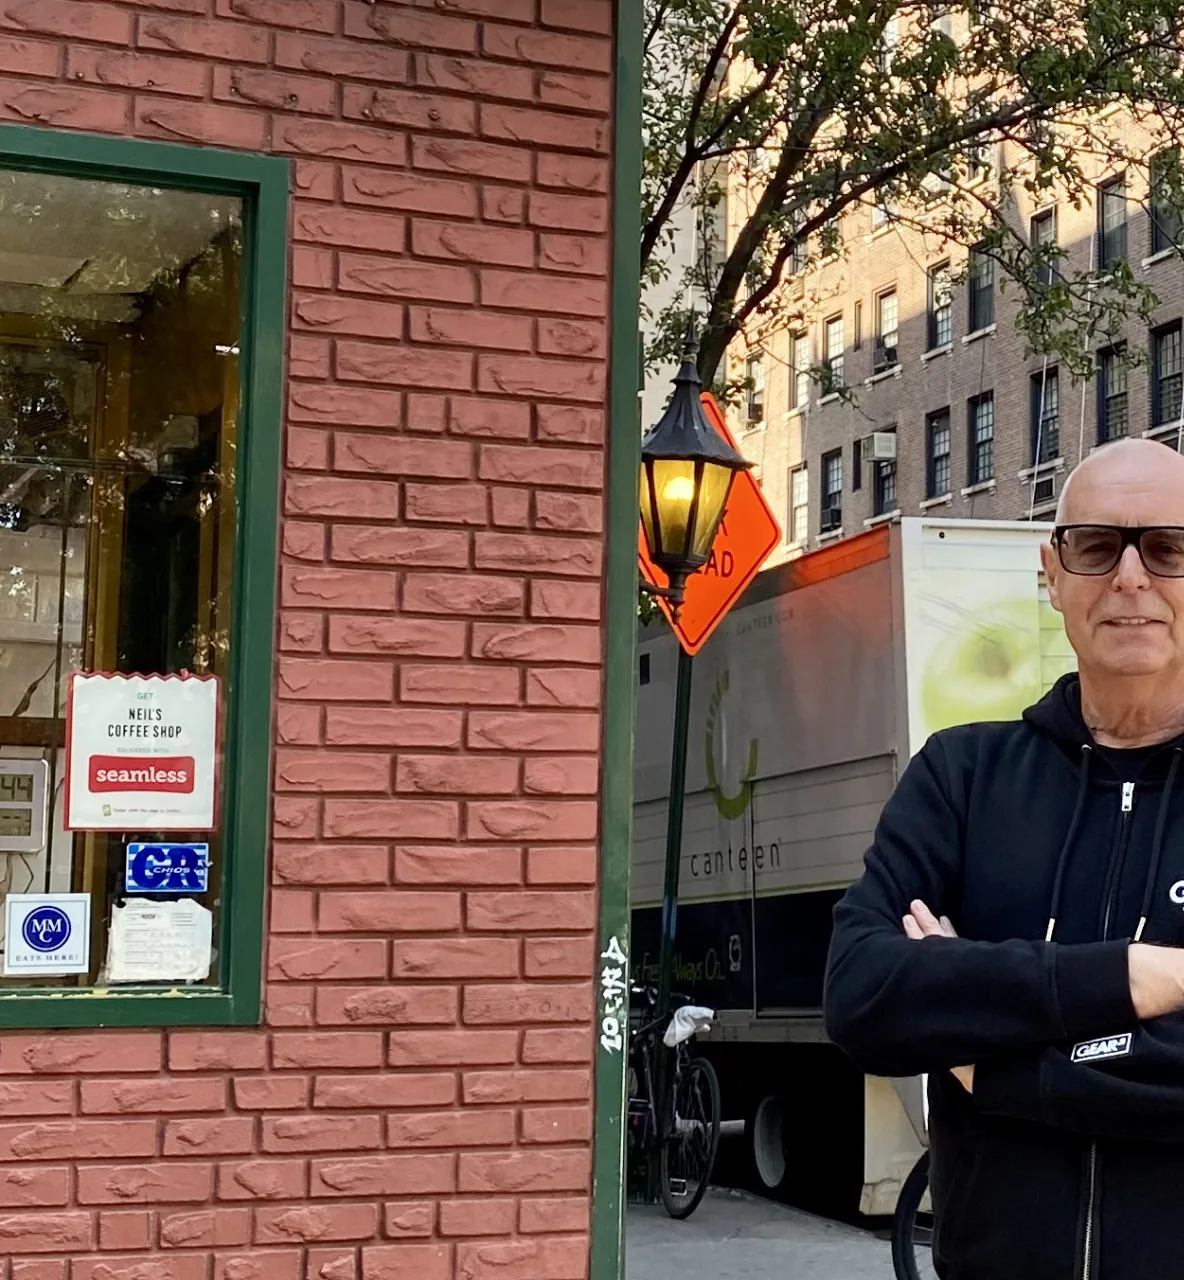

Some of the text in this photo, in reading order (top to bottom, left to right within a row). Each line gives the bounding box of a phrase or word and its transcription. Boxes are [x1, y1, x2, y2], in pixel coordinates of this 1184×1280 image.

[136, 692, 154, 700] GET
[129, 708, 162, 721] NEIL'S
[108, 724, 182, 738] COFFEE SHOP
[96, 766, 188, 783] seamless
[691, 841, 780, 877] canteen
